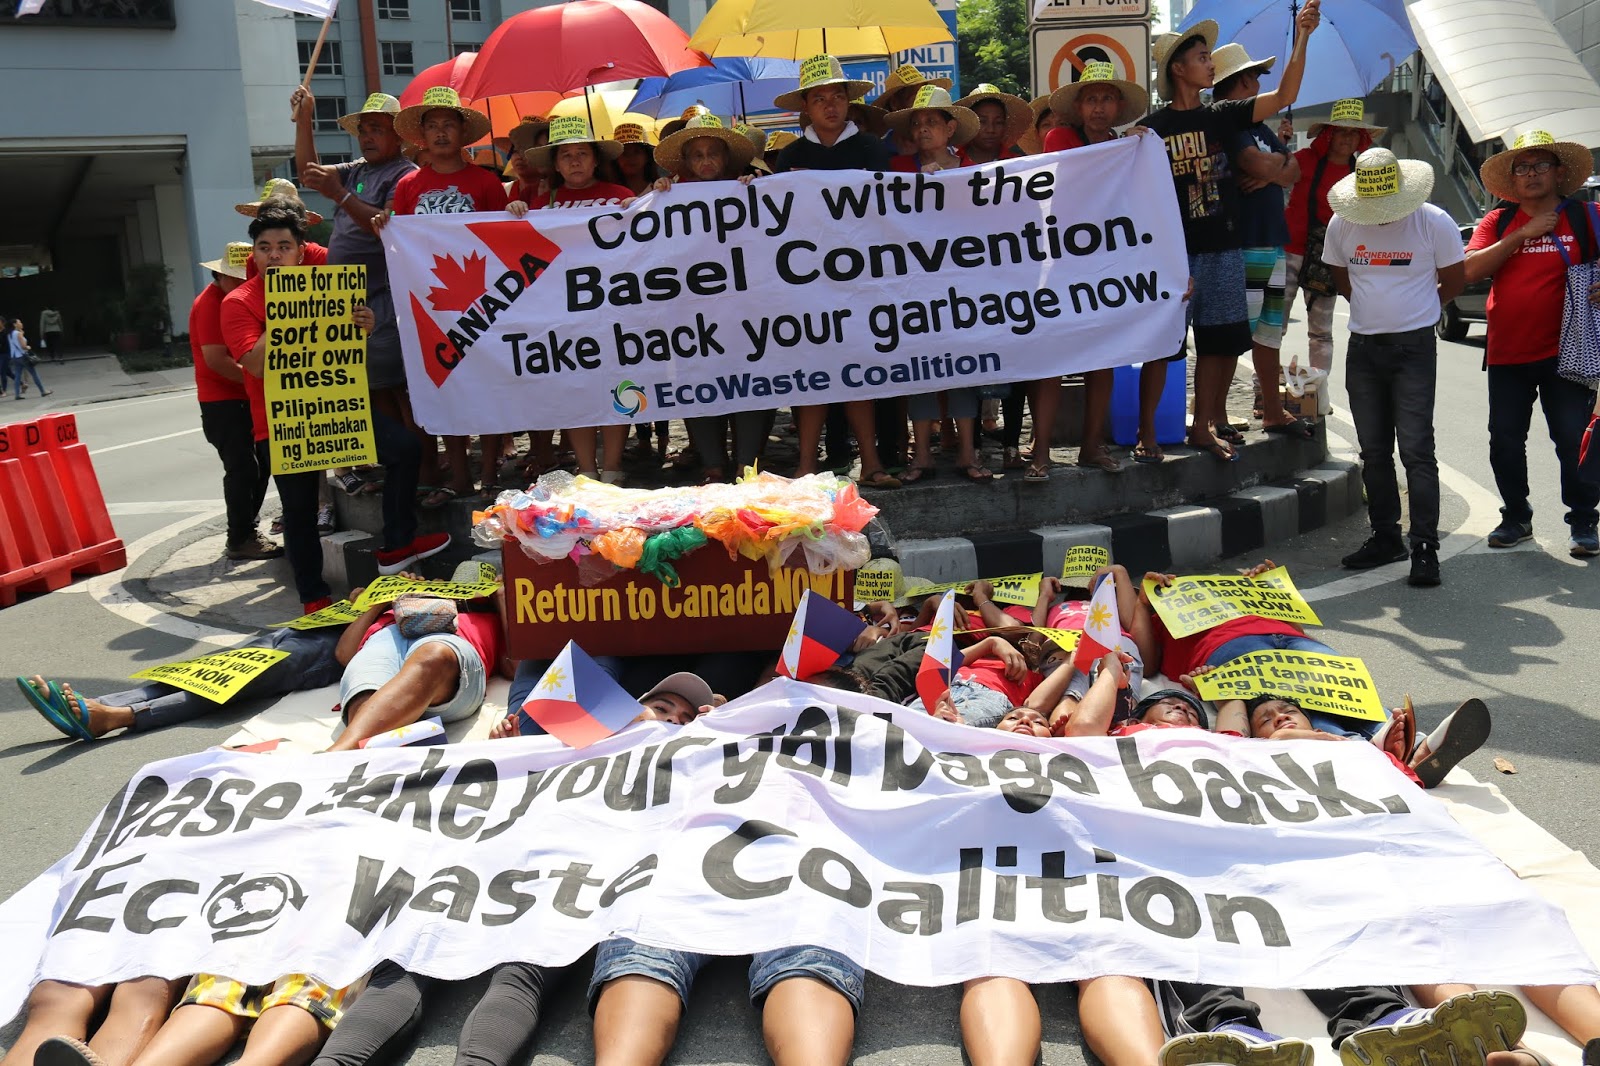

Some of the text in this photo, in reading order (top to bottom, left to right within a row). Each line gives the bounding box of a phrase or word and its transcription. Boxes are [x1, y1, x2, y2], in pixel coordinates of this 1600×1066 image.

[1164, 131, 1207, 161] FUBU
[1172, 160, 1194, 176] EST.
[1356, 165, 1396, 177] Canada:
[1369, 175, 1383, 184] back
[1384, 174, 1396, 184] your
[1358, 183, 1396, 193] trash NOW.
[588, 166, 1055, 250] Comply with the
[565, 215, 1153, 312] Basel Convention.
[1354, 249, 1413, 259] INCINERATION
[266, 266, 366, 293] Time for rich
[266, 293, 345, 320] countries
[434, 252, 551, 371] CANADA
[270, 320, 363, 346] sort out
[502, 270, 1170, 377] Take back your garbage now.
[268, 346, 363, 370] their own
[280, 368, 356, 390] mess.
[654, 352, 1001, 409] EcoWaste Coalition
[271, 397, 365, 420] Pilipinas:
[26, 425, 40, 446] D
[273, 416, 368, 442] Hindi tambakan
[282, 436, 365, 461] ng basura.
[291, 454, 368, 469] EcoWaste Coalition
[1067, 547, 1107, 556] Canada:
[1094, 557, 1107, 565] your
[1066, 564, 1083, 572] trash
[368, 586, 417, 600] trash
[423, 586, 475, 596] NOW.
[374, 581, 409, 589] Take
[455, 584, 491, 592] your
[872, 589, 891, 597] NOW.
[880, 580, 893, 589] your
[993, 580, 1026, 592] OW.
[1153, 577, 1285, 598] Canada:
[514, 578, 622, 625] Return
[626, 583, 656, 622] to
[662, 570, 771, 619] Canada
[1161, 587, 1292, 611] Take back your
[1177, 599, 1302, 625] trash NOW.
[1256, 609, 1306, 621] Coalition
[191, 667, 236, 689] NOW.
[222, 659, 259, 675] your
[1202, 665, 1368, 690] Hindi tapunan
[184, 678, 220, 696] Coalition
[1217, 678, 1363, 703] ng basura.
[1305, 698, 1367, 714] Coalition
[318, 748, 499, 842] take
[475, 736, 716, 843] your
[1116, 737, 1411, 826] back.
[702, 819, 1291, 948] Coalition
